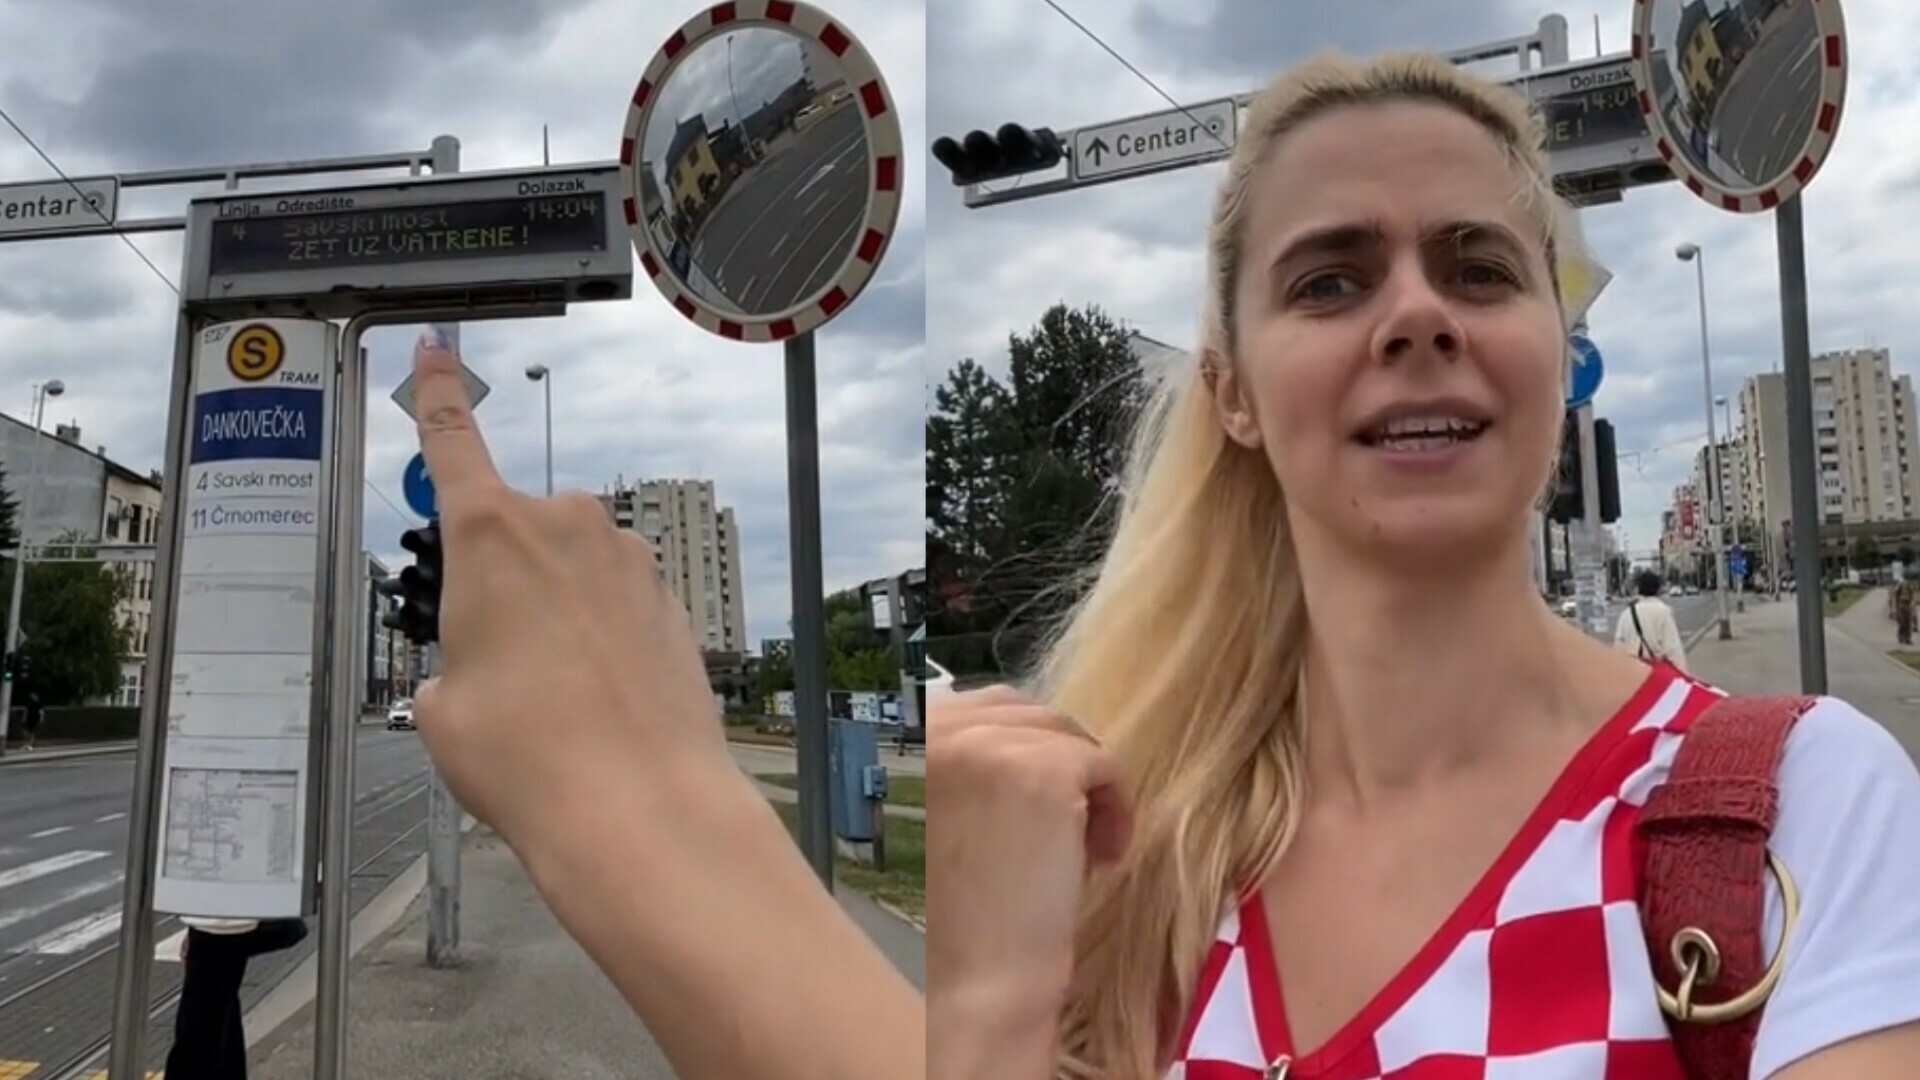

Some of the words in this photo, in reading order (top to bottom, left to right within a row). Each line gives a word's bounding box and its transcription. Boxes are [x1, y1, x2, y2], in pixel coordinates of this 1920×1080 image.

[1117, 125, 1199, 156] Centar
[0, 195, 77, 220] entar
[220, 204, 260, 217] Linija
[277, 197, 354, 213] Odredište
[518, 178, 585, 196] Dolazak
[232, 223, 246, 240] 4
[288, 238, 340, 261] ZET
[348, 236, 380, 256] UZ
[241, 336, 268, 369] S
[279, 371, 319, 385] TRAM
[202, 405, 306, 442] DANKOVEČKA
[196, 471, 208, 491] 4
[214, 471, 264, 489] Savski
[269, 472, 313, 488] most
[192, 508, 207, 529] 11
[211, 504, 315, 525] Črnomerec
